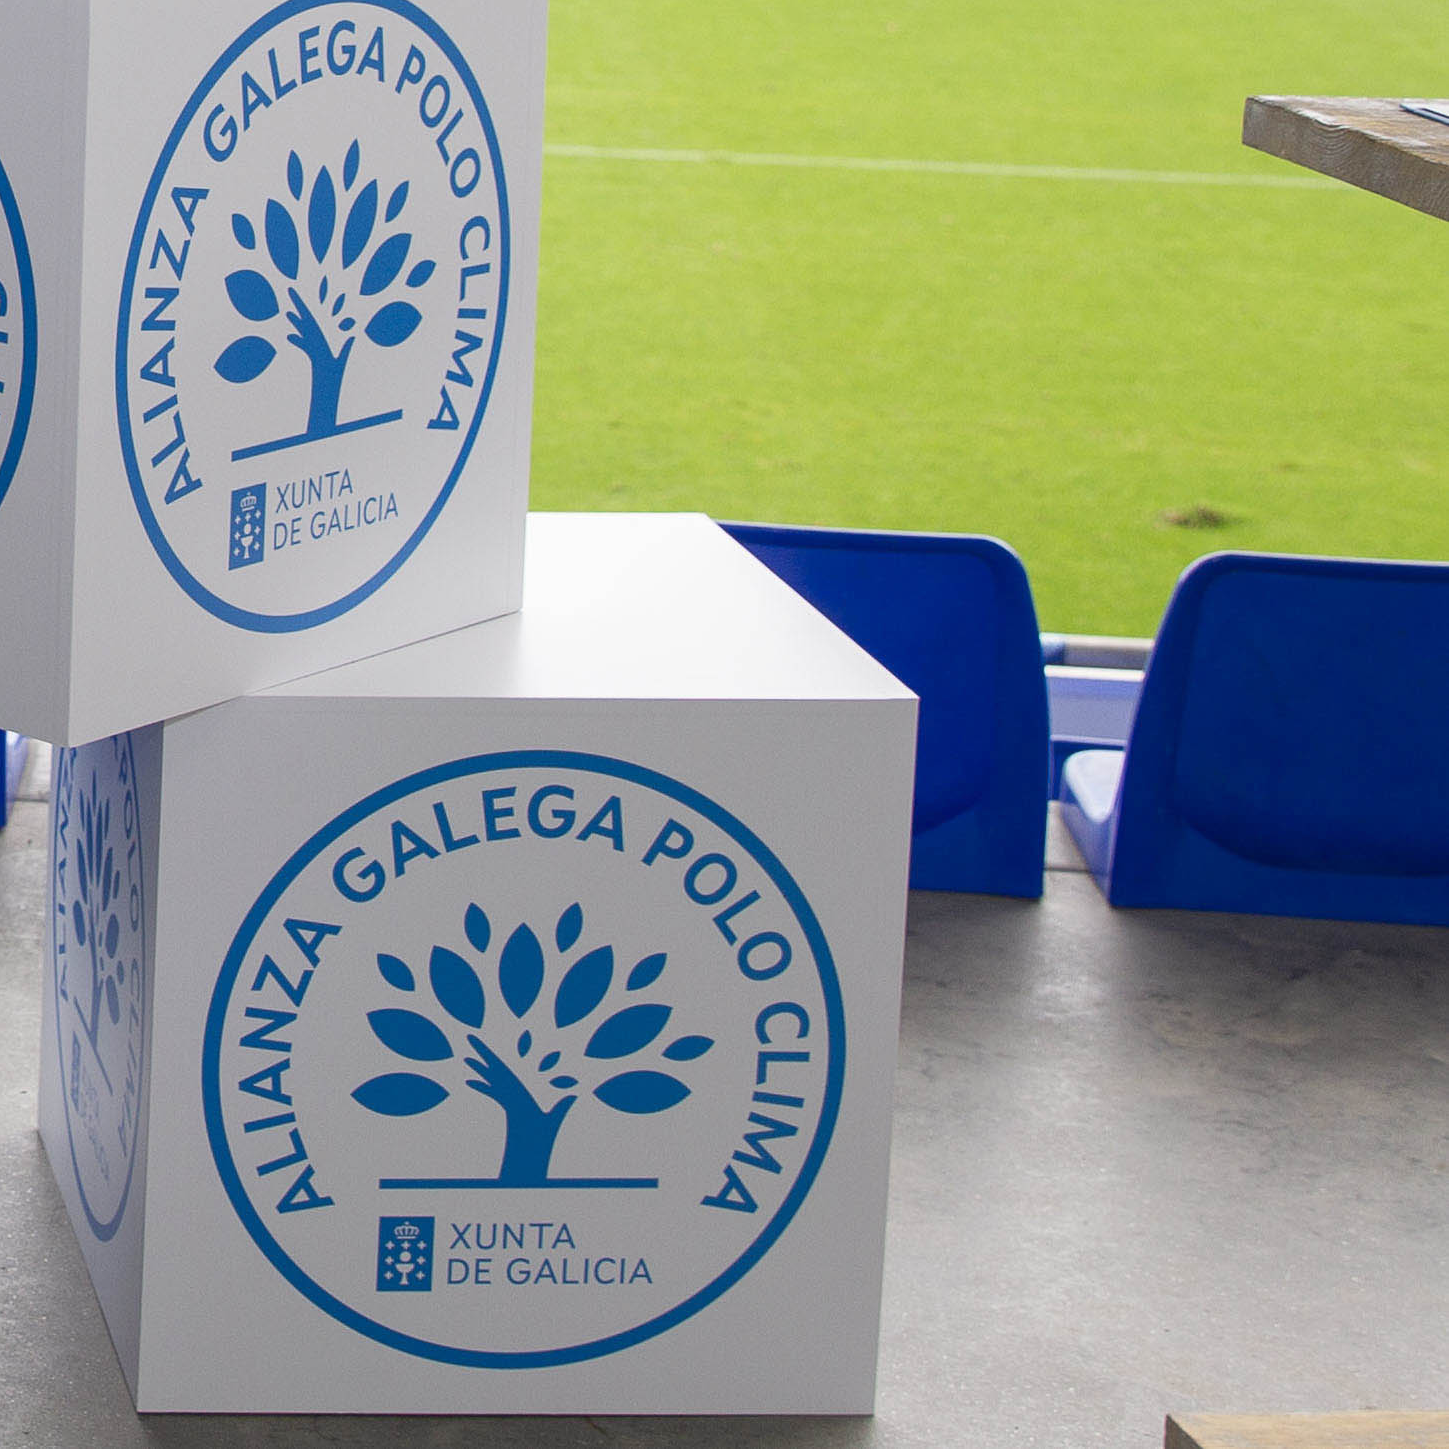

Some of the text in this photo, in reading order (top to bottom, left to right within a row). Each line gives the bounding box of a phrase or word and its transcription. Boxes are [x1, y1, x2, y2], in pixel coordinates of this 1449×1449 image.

[139, 19, 491, 505] ALIANZA GALEGA POLO CLIMA
[274, 492, 399, 551] DE GALICIA
[275, 468, 353, 514] XUNTA
[332, 784, 626, 904] GALEGA
[640, 818, 793, 982] POLO
[238, 917, 343, 1215] ALIANZA
[700, 1001, 811, 1215] CLIMA
[446, 1257, 653, 1286] DE GALICIA
[450, 1222, 576, 1250] XUNTA
